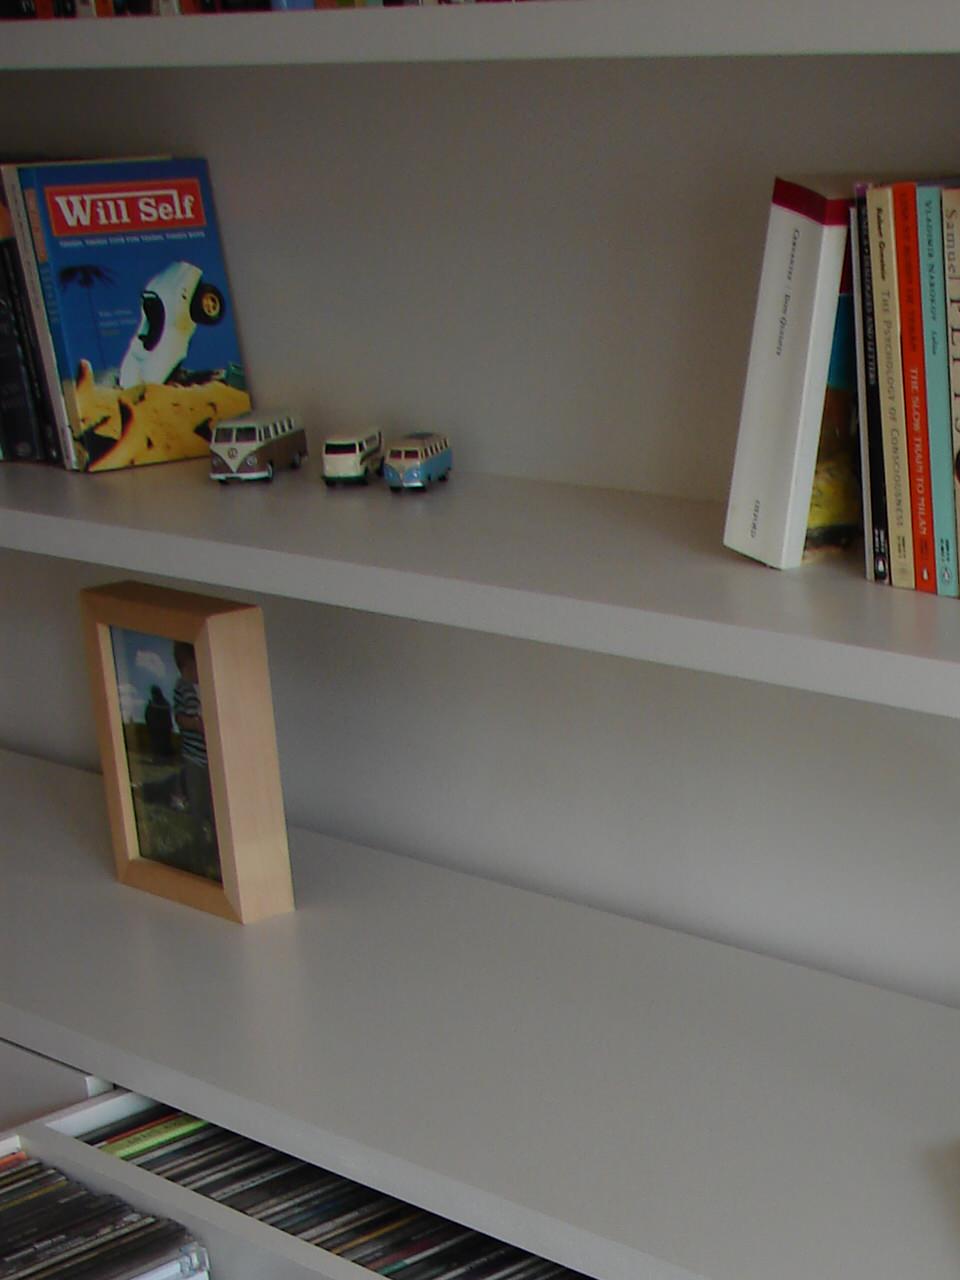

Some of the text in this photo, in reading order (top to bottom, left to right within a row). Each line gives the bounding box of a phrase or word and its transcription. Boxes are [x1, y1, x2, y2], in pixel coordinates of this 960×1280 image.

[55, 188, 197, 227] Will Self
[924, 200, 935, 259] VLADIMIR
[945, 208, 960, 282] Samuel
[926, 263, 938, 323] NABOKOV
[910, 367, 921, 391] THE
[914, 436, 925, 473] TRAIN
[916, 477, 925, 494] TO
[917, 496, 928, 536] MILAN
